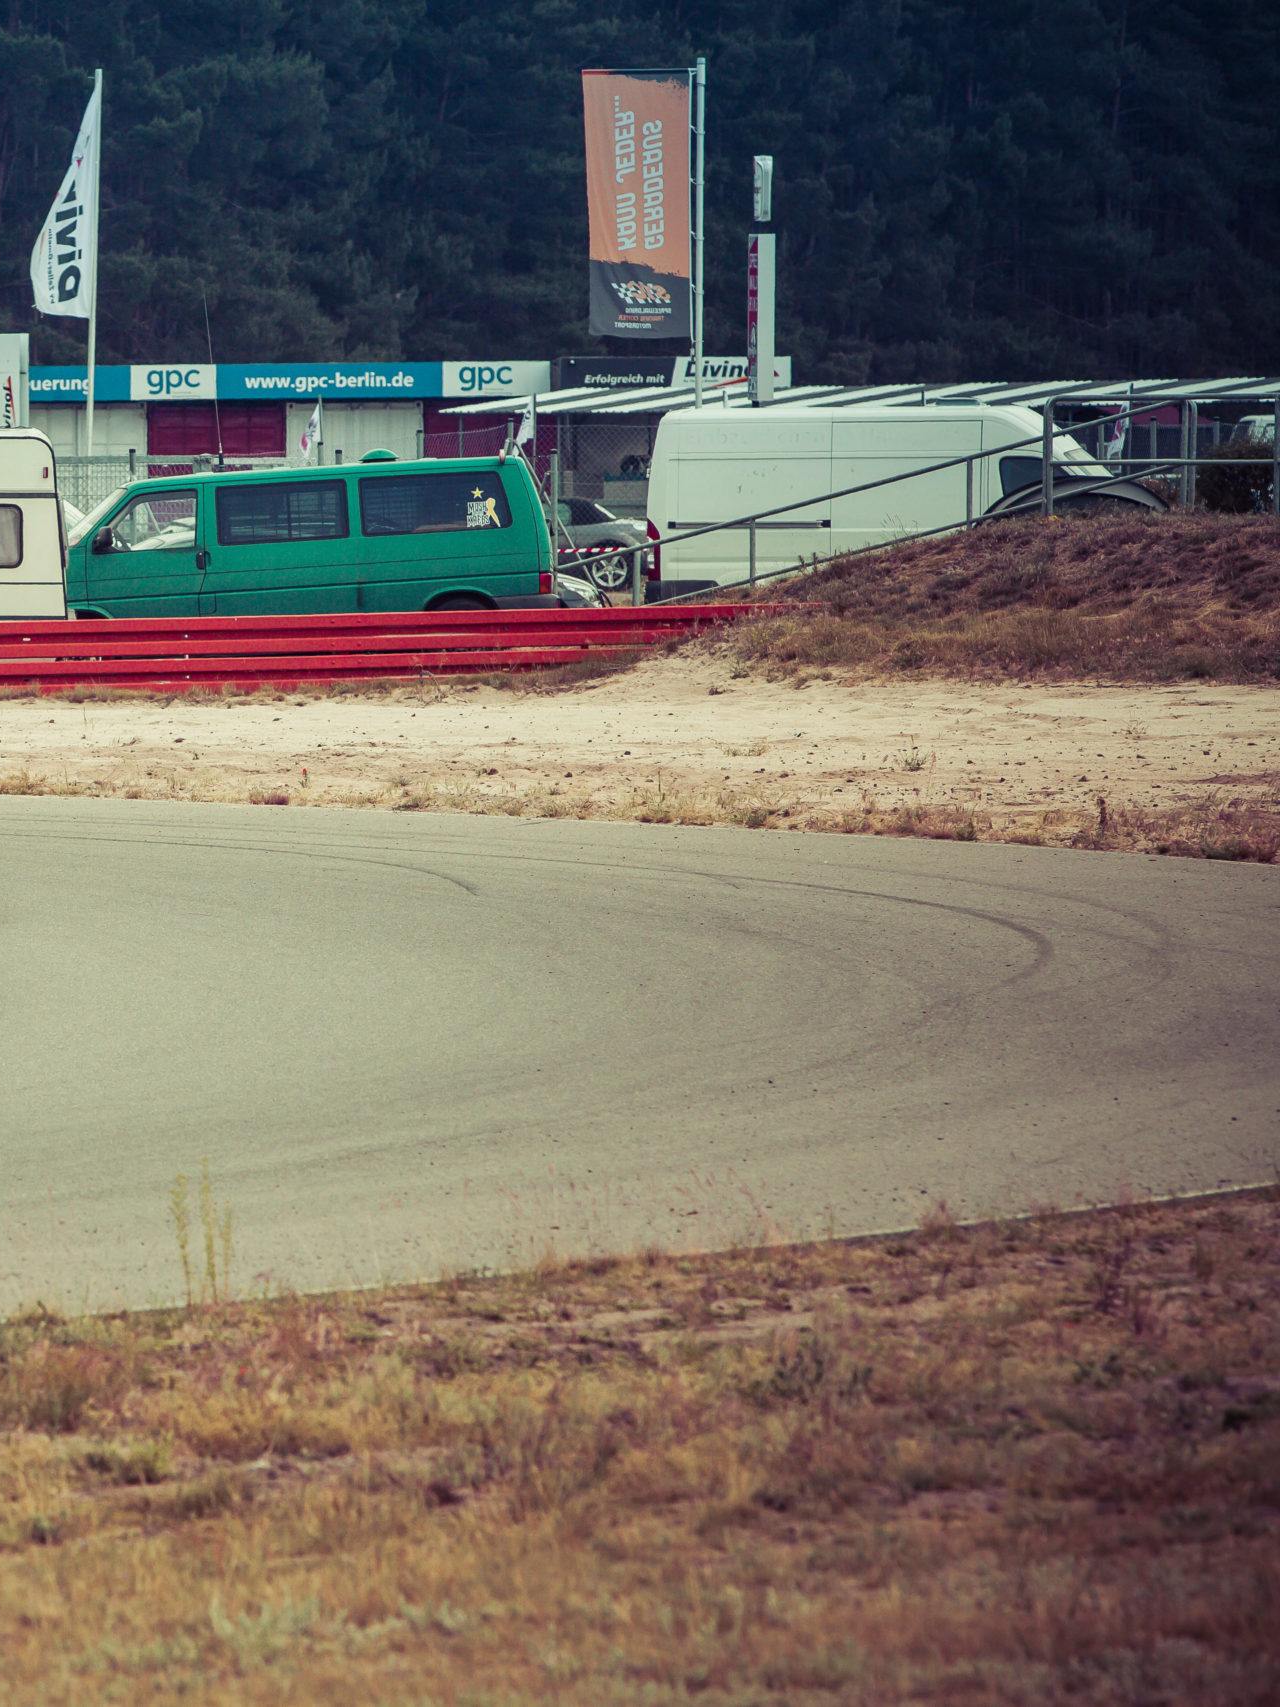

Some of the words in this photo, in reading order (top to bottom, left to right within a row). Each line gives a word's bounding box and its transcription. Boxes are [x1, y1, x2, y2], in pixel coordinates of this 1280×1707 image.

[147, 369, 200, 394] gpc
[244, 371, 415, 392] www.gpc-berlin.de
[458, 366, 513, 391] gpc
[584, 373, 643, 386] Erfolgreich
[645, 373, 666, 383] mit
[2, 386, 12, 428] vinol
